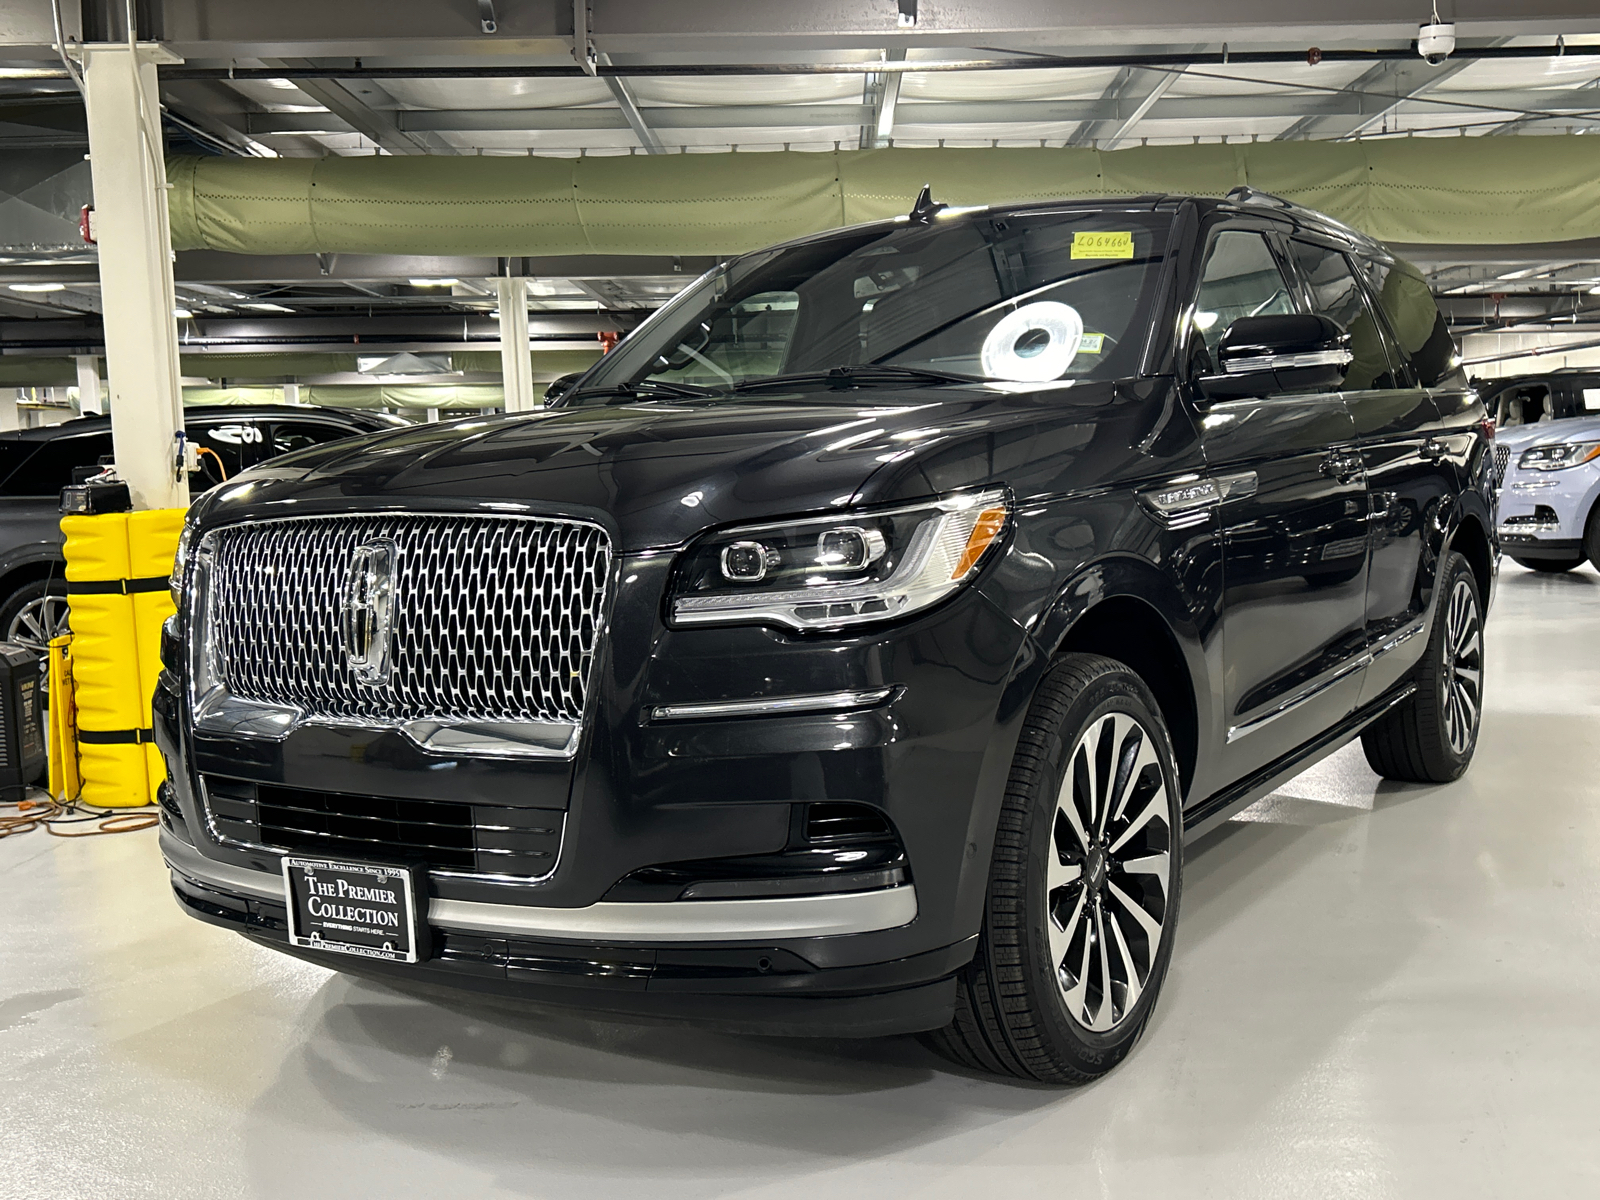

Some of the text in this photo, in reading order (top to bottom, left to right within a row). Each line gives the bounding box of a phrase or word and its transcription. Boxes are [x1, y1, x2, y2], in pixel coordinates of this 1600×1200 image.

[291, 859, 400, 878] AUTOMOTIVE EXCELLENCE SINCE 1995
[304, 876, 397, 904] THE PREMIER
[307, 896, 399, 927] COLLECTION
[322, 921, 353, 932] EVERYTHING
[352, 926, 370, 934] STARTS
